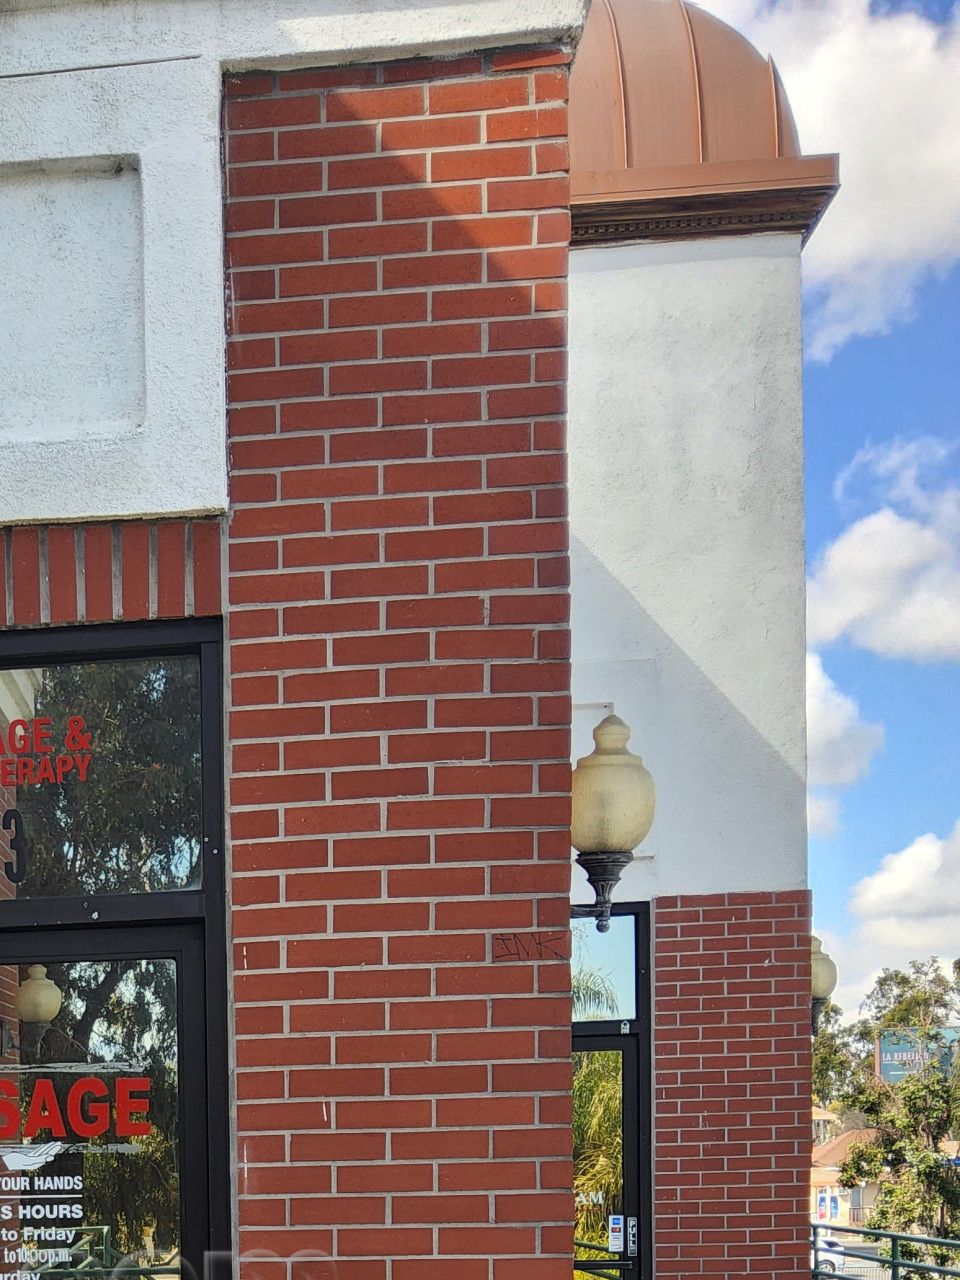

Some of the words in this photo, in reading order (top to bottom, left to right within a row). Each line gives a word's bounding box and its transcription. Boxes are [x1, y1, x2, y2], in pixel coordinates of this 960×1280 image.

[65, 715, 93, 751] &
[34, 1175, 83, 1190] HANDS
[18, 1204, 83, 1219] HOURS
[0, 1228, 18, 1242] to
[23, 1226, 76, 1244] Friday
